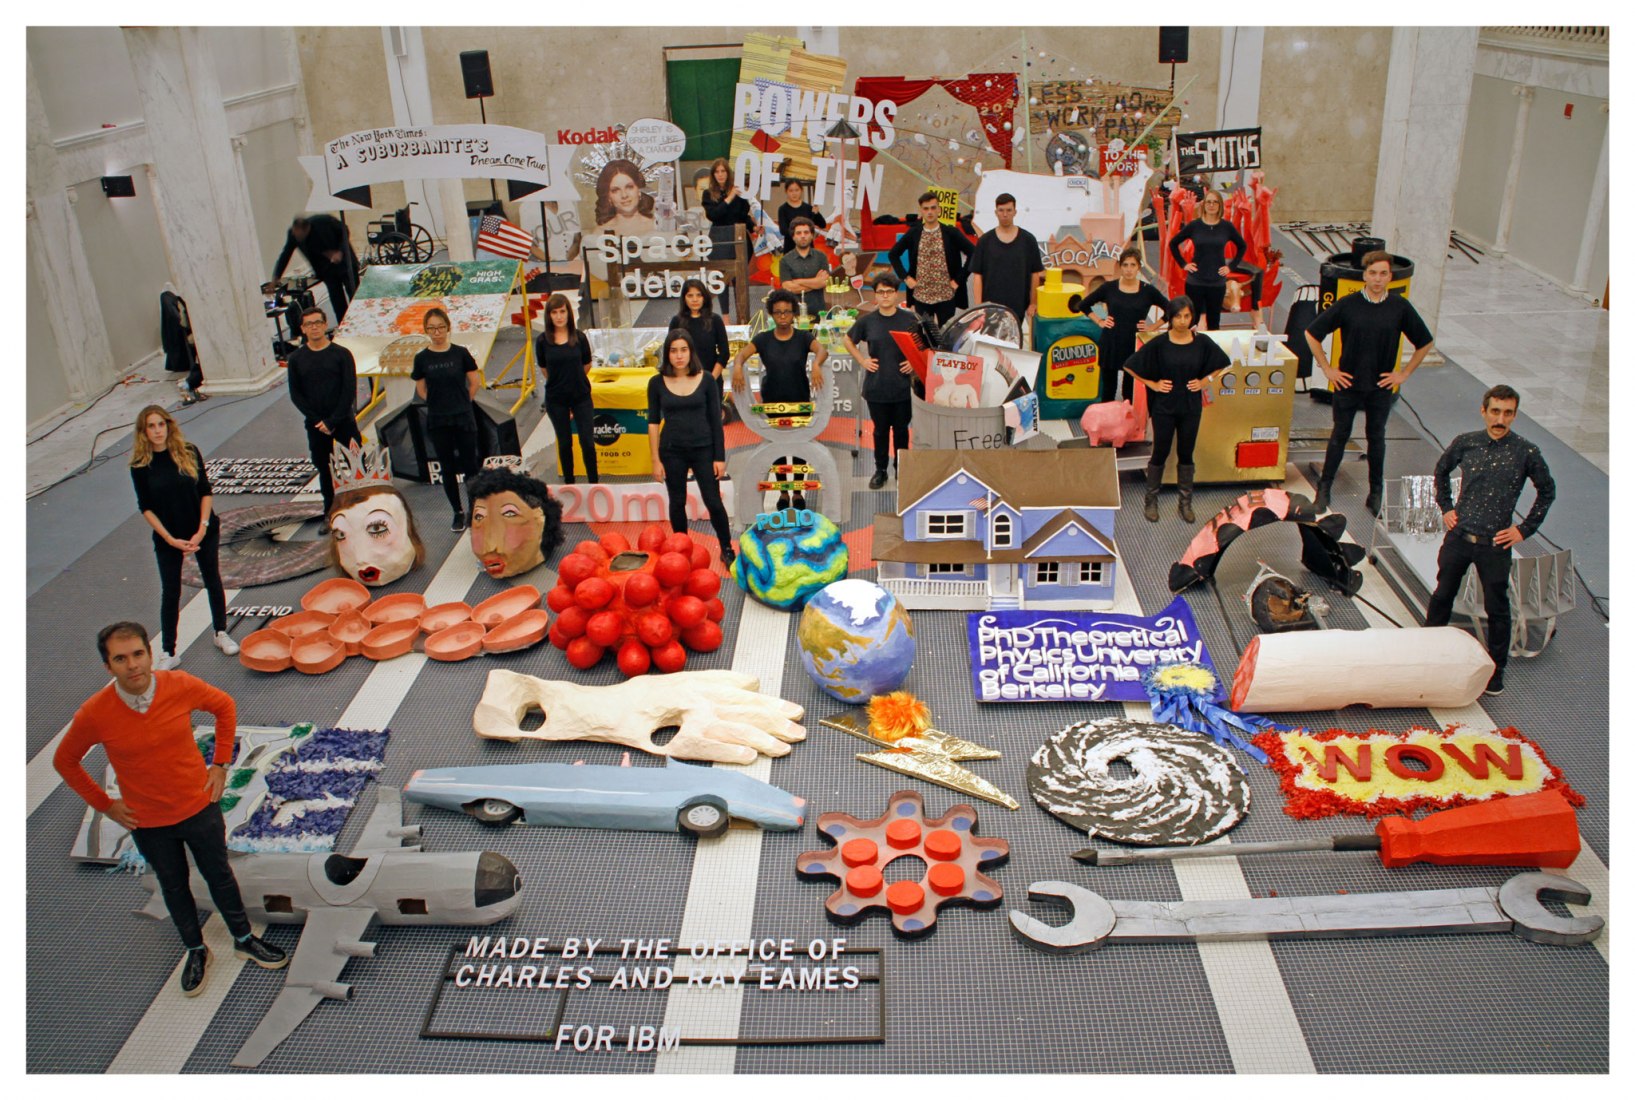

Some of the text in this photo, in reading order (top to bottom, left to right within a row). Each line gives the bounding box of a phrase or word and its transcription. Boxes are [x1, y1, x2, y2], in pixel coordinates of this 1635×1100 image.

[732, 83, 897, 151] POWERS
[330, 139, 350, 154] The
[351, 132, 372, 145] New
[372, 130, 395, 145] York
[557, 126, 621, 145] Kodak
[336, 154, 349, 170] A
[1180, 134, 1260, 170] THE SMITHS
[733, 151, 785, 201] OF
[811, 157, 884, 212] TEN
[936, 358, 979, 371] PLAYBOY
[1052, 344, 1095, 363] ROUNDUP
[228, 464, 292, 473] RELATIVE
[756, 508, 816, 531] POLIO
[256, 605, 293, 616] END
[978, 619, 1189, 648] PhD Theoretical
[980, 640, 1202, 666] Physics University
[979, 663, 1140, 684] of California
[982, 679, 1106, 700] Berkeley
[465, 936, 848, 961] MADE BY THE OFFICE OF
[454, 964, 860, 990] CHARLES AND RAY EAMES
[554, 1024, 682, 1052] FOR IBM
